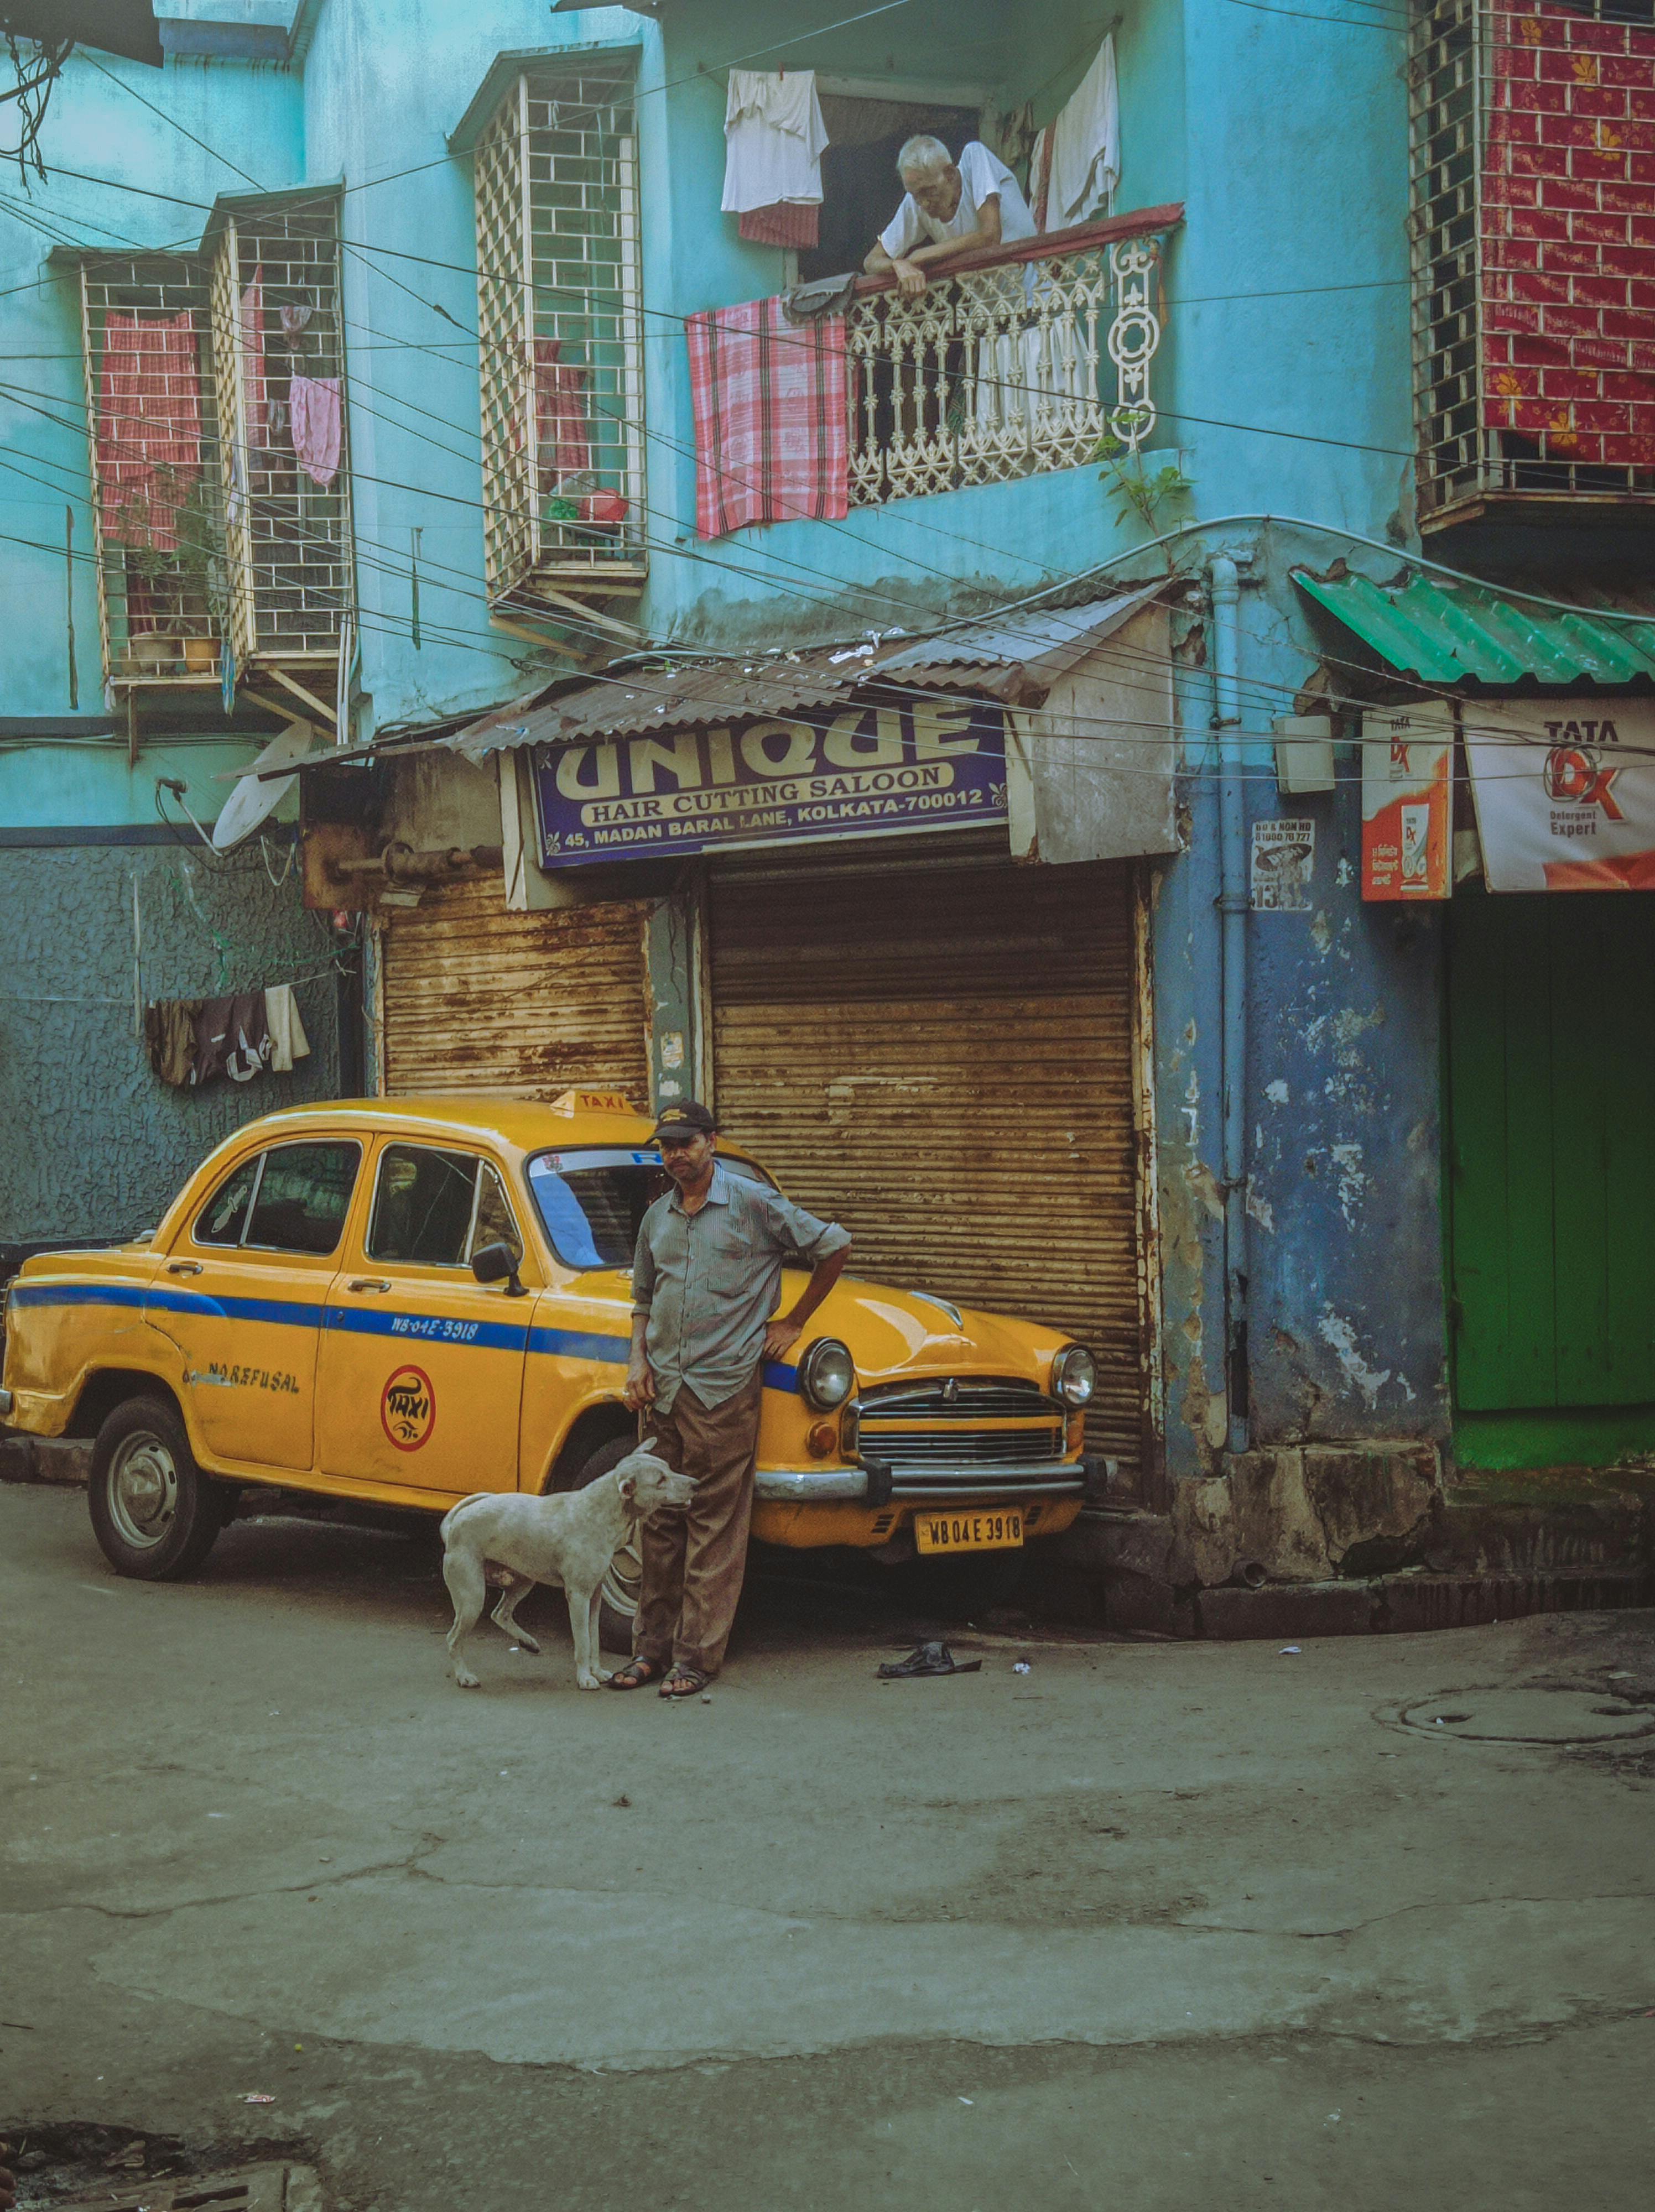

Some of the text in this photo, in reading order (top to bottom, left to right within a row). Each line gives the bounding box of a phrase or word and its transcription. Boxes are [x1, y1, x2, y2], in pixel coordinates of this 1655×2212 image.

[1390, 717, 1410, 731] TATA
[1543, 721, 1619, 742] TATA
[556, 698, 980, 801] UNIQUE
[591, 766, 940, 823] HAIR CUTTING SALOON
[565, 789, 983, 848] 45, MADAN BARAL LANE, KOLKATA-700012
[1279, 822, 1297, 831] NON
[1299, 822, 1311, 831] HD
[1550, 811, 1596, 821] Detergent
[1550, 822, 1596, 838] Expert
[580, 1095, 624, 1109] TAXI
[388, 1378, 429, 1420] TAXI
[930, 1516, 1021, 1545] WB 04 E 3918
